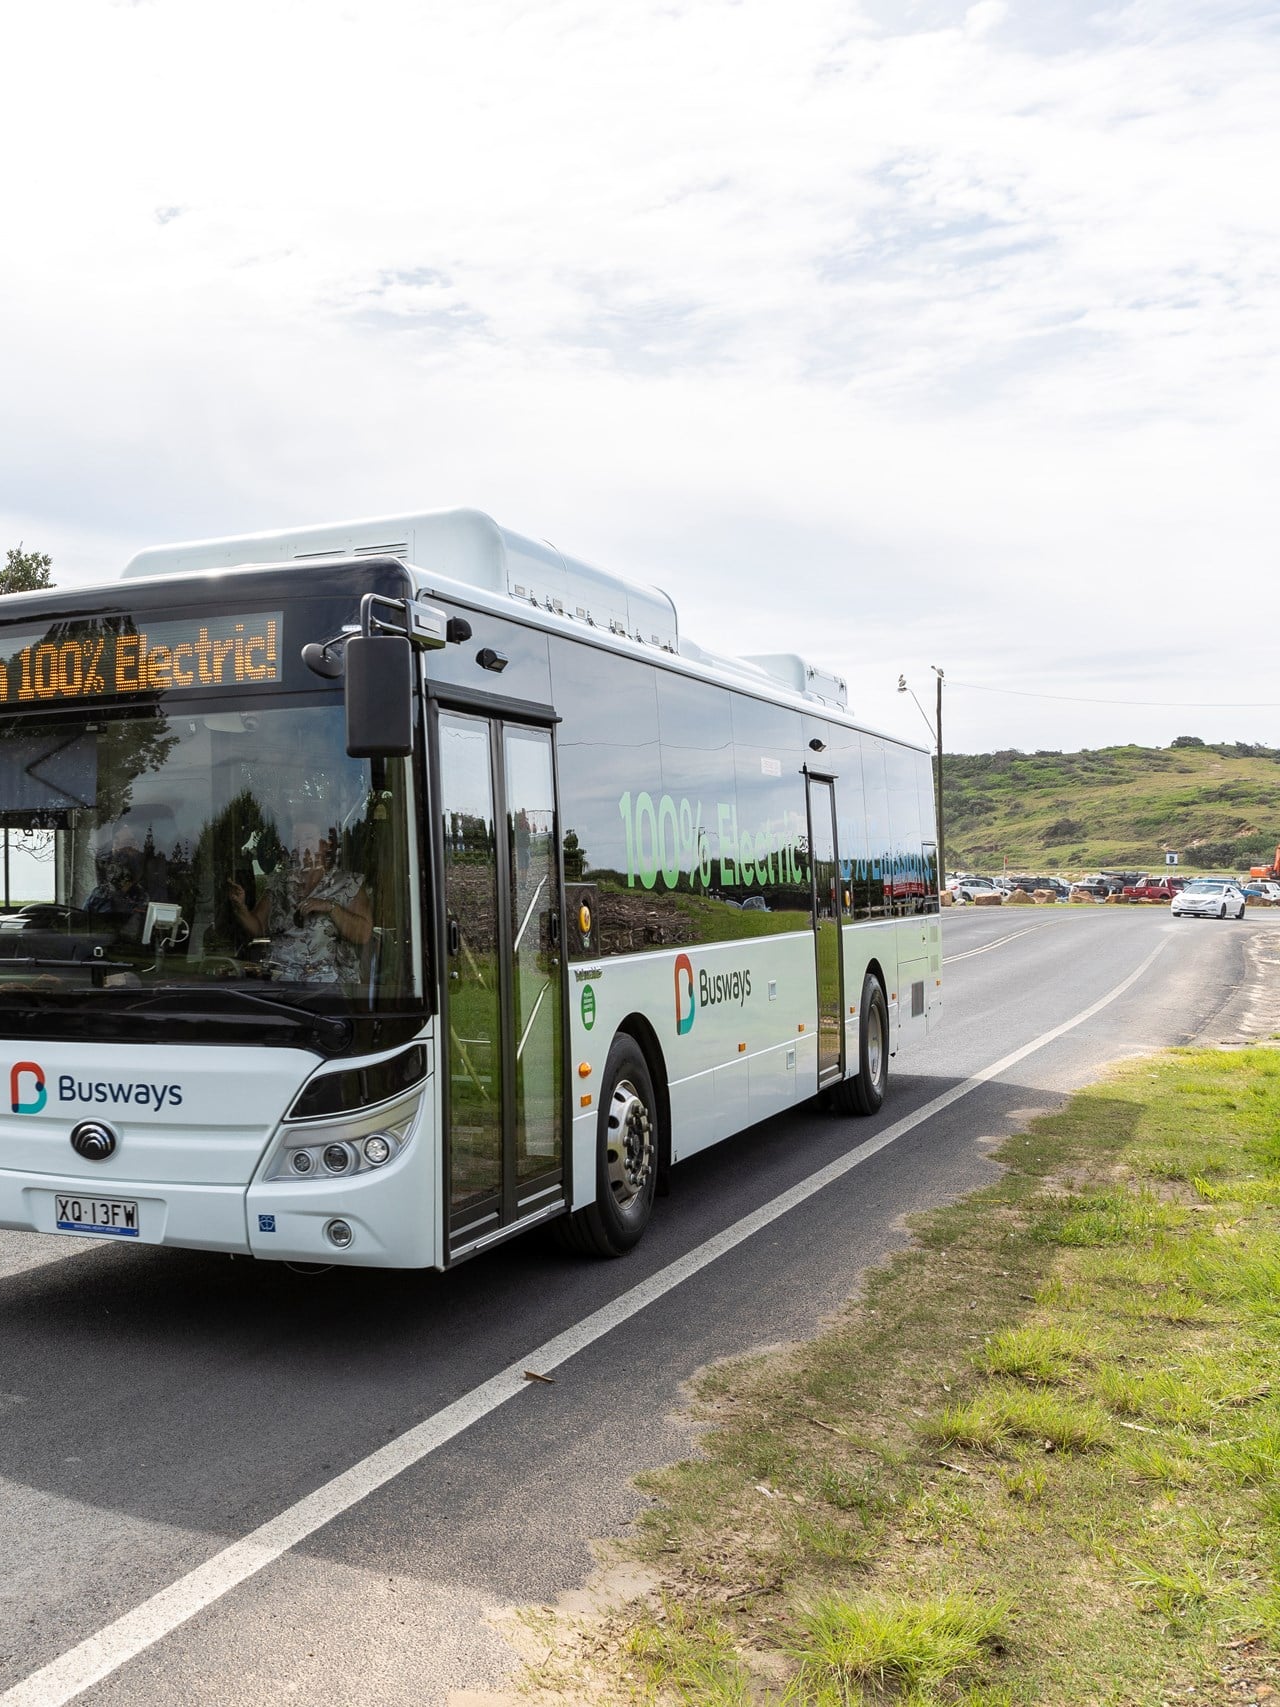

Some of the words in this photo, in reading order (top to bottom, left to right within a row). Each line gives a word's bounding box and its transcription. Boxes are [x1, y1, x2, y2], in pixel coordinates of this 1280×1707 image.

[17, 638, 105, 700] 100%
[115, 620, 276, 691] Electric!
[619, 791, 712, 889] 100%
[700, 968, 752, 1007] Busways
[59, 1075, 183, 1112] Busways
